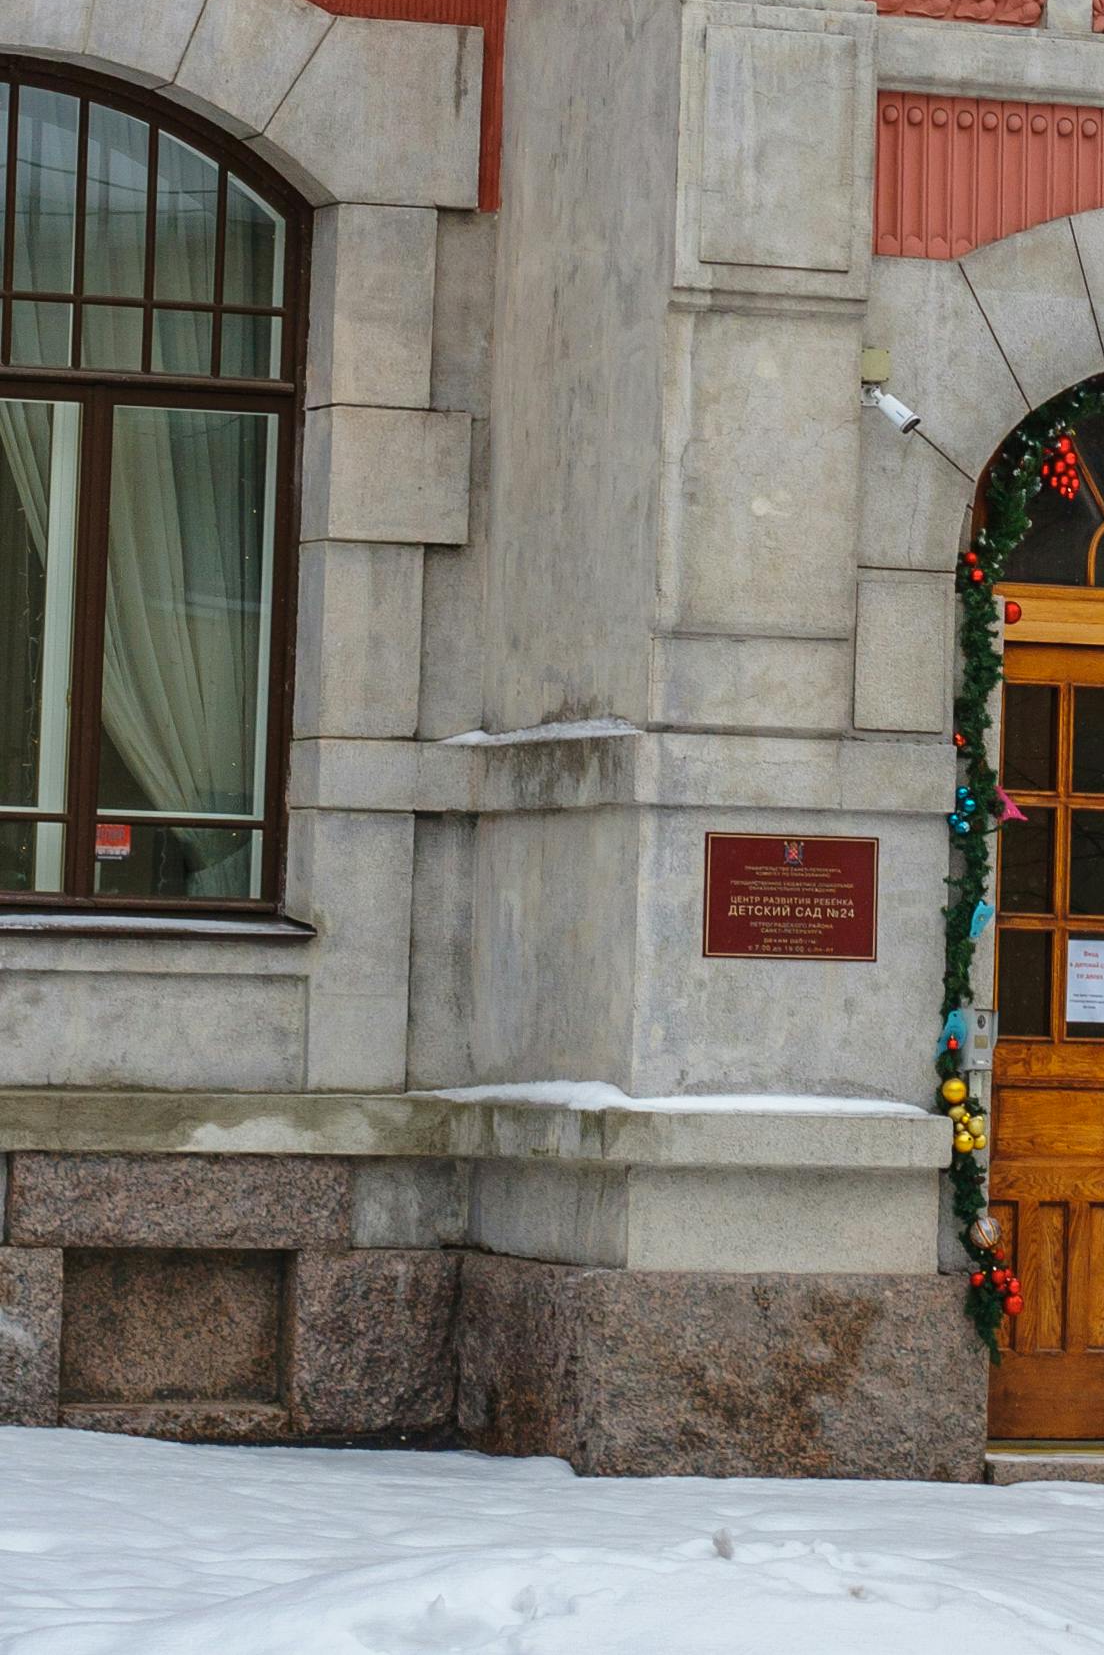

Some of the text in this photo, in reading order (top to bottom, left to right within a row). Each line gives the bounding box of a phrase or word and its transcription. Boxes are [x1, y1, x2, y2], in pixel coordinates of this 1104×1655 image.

[730, 895, 760, 904] ЦЕНТР
[763, 896, 811, 905] РАЗВИТИЯ
[728, 904, 855, 919] ДЕТСКИЙ САД №24
